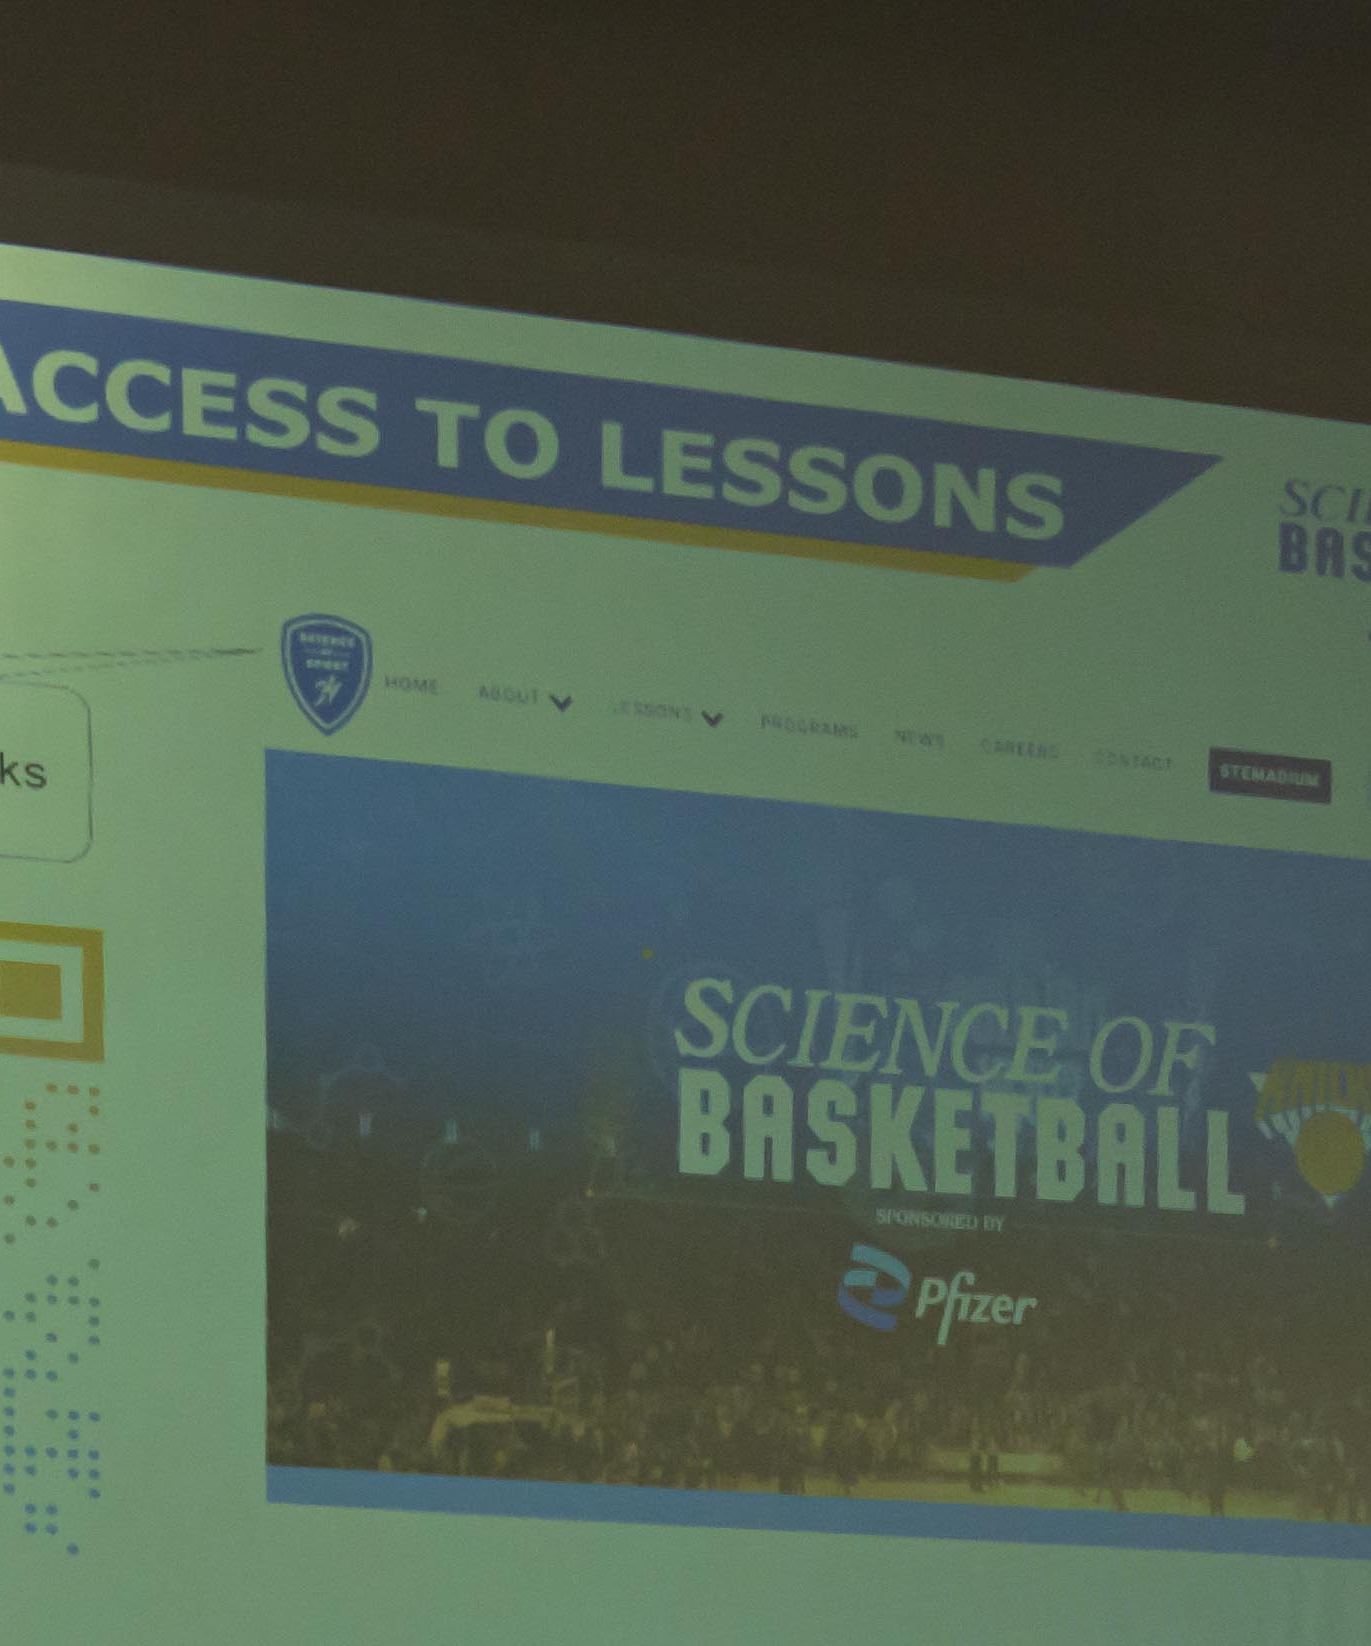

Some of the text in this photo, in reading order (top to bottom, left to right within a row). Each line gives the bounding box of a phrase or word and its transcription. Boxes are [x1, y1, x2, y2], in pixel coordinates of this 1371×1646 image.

[415, 397, 559, 480] TO
[600, 421, 1065, 540] LESSONS
[674, 977, 1216, 1097] SCIENCE OF
[677, 1068, 1246, 1215] BASKETBALL
[914, 1270, 1038, 1346] Pfizer
